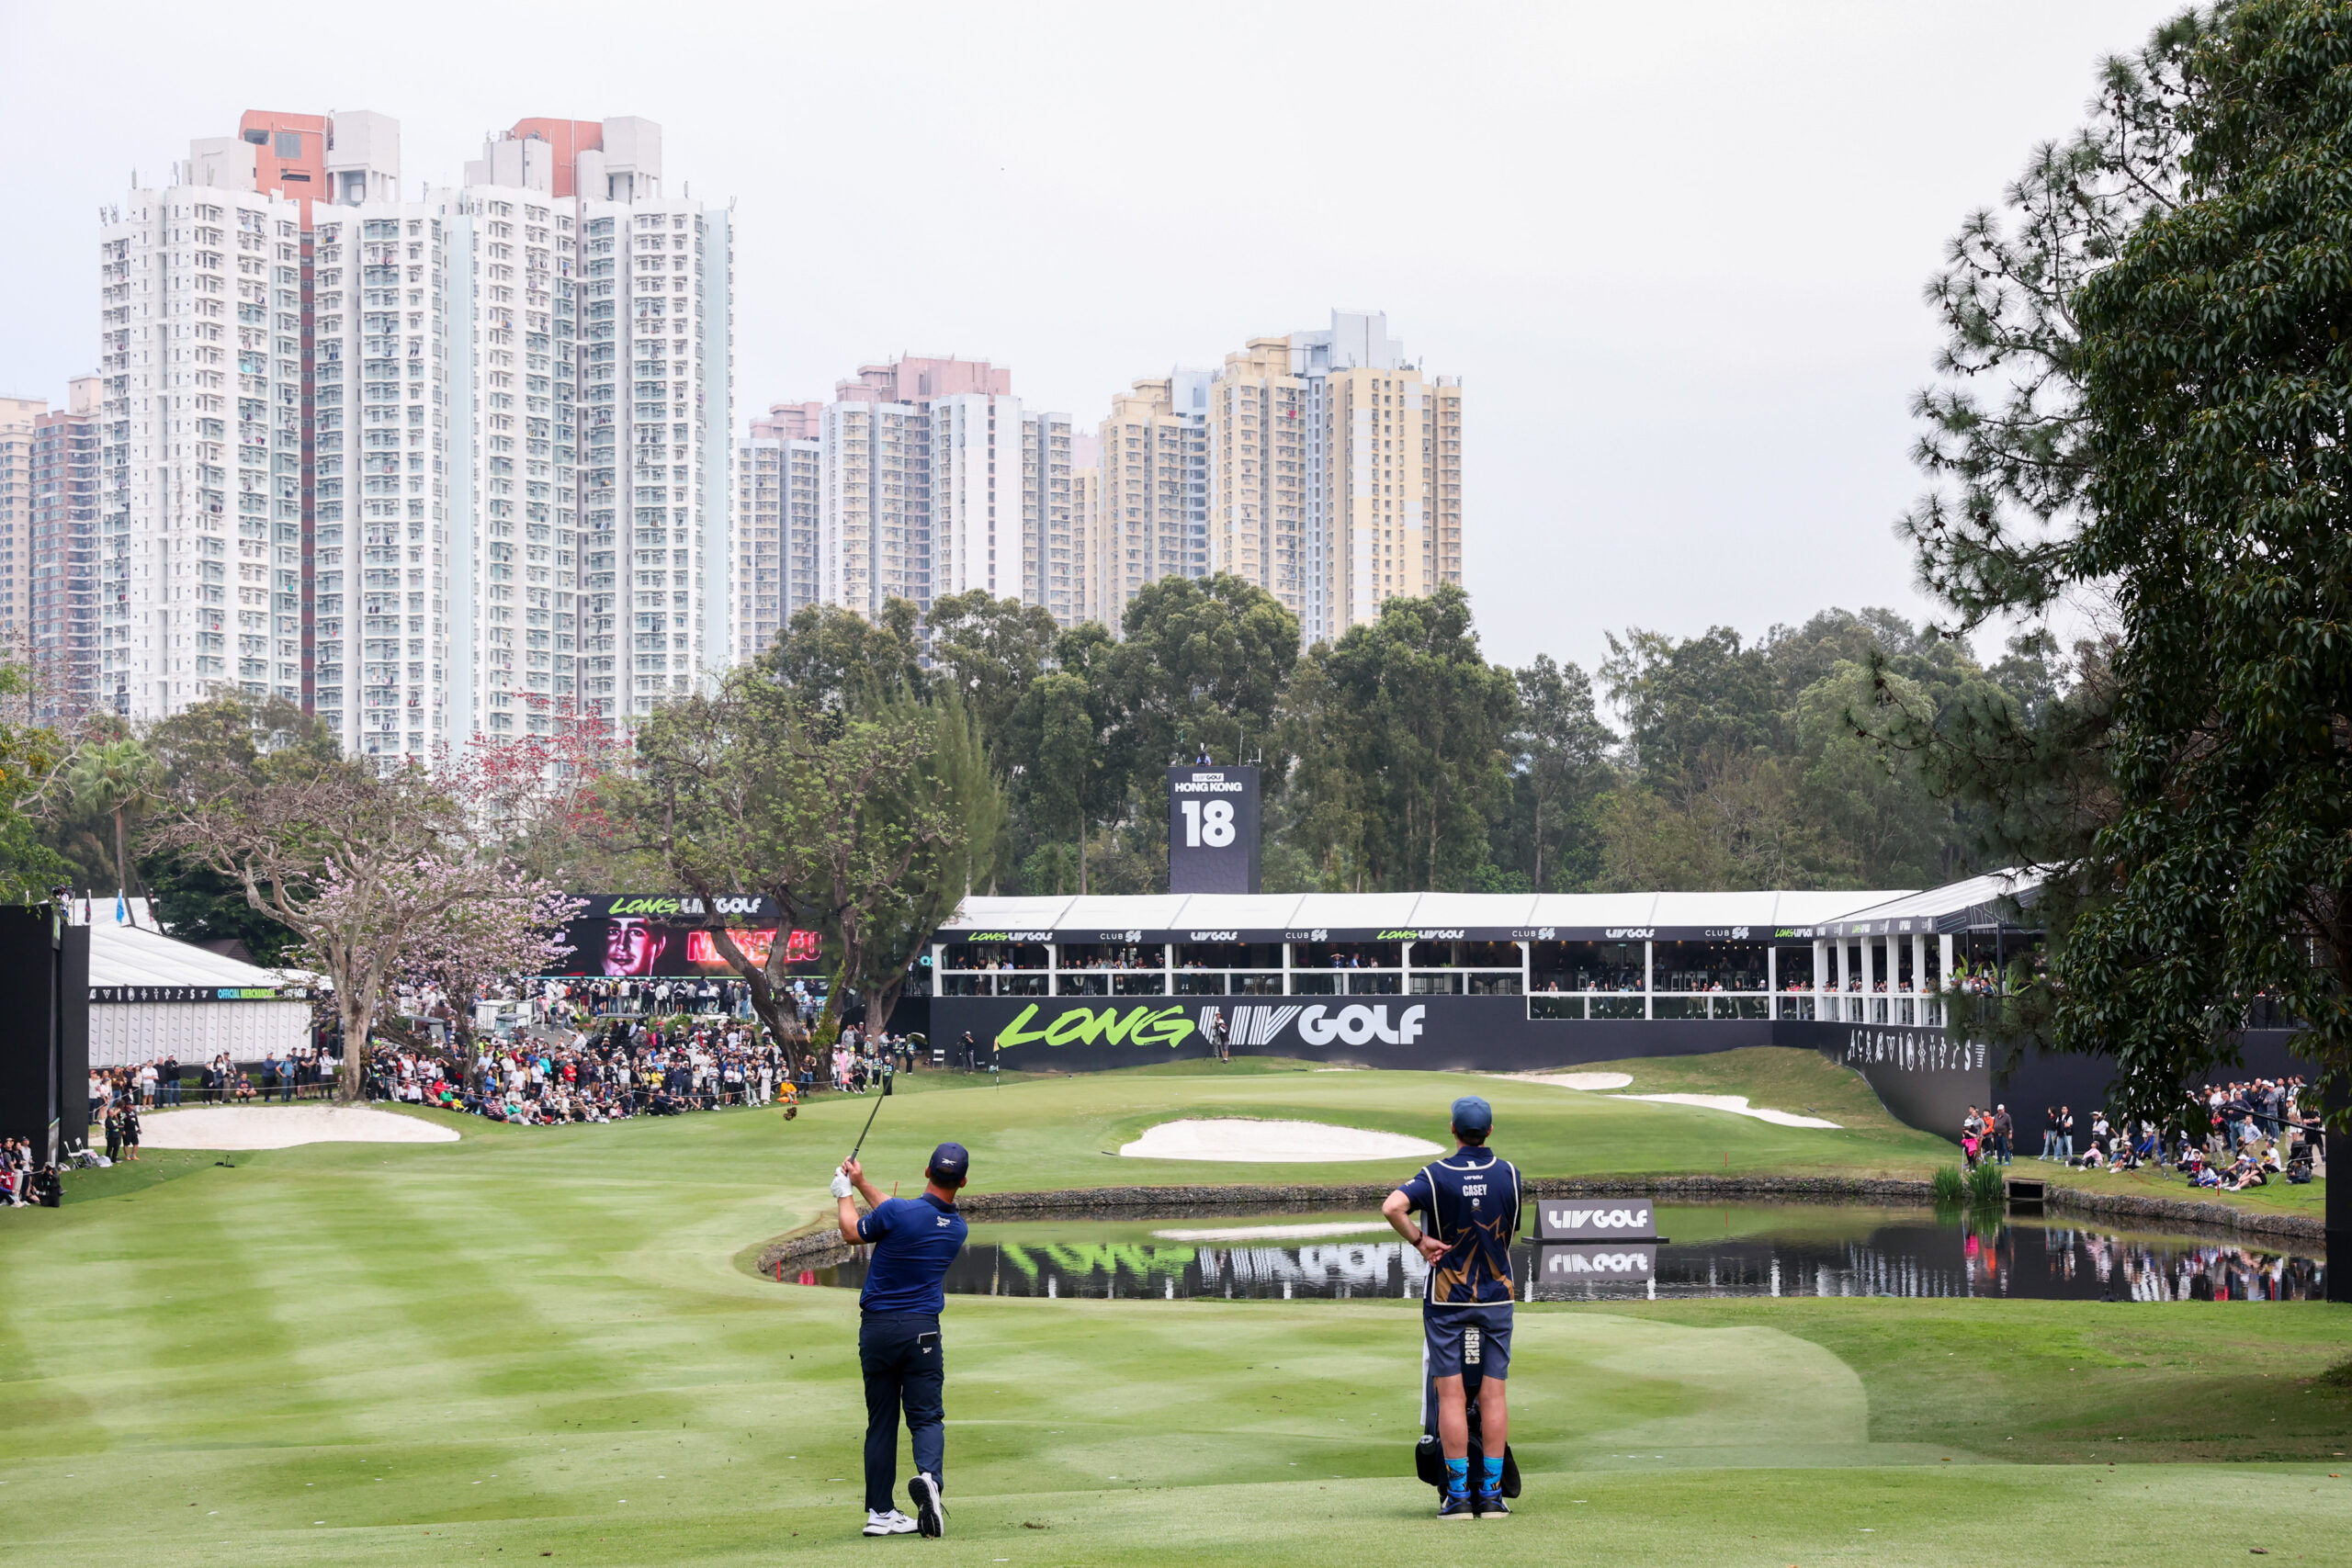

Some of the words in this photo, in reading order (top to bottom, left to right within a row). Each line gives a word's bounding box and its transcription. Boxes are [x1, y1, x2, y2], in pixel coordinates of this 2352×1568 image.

[1175, 783, 1209, 793] HONG
[1209, 782, 1243, 792] KONG
[1182, 799, 1236, 848] 18
[608, 897, 681, 915] LONG
[716, 897, 762, 914] GOLF
[967, 931, 1008, 942] LONG
[1100, 932, 1123, 941] CLUB
[1376, 930, 1419, 941] LONG
[1512, 930, 1536, 938] CLUB
[1704, 929, 1730, 937] CLUB
[218, 988, 241, 999] OFFICIAL
[997, 1003, 1194, 1049] LONG
[1297, 1004, 1426, 1046] GOLF
[1462, 1183, 1487, 1197] CASEY
[1591, 1209, 1648, 1228] GOLF
[1464, 1325, 1480, 1364] CRUSH
